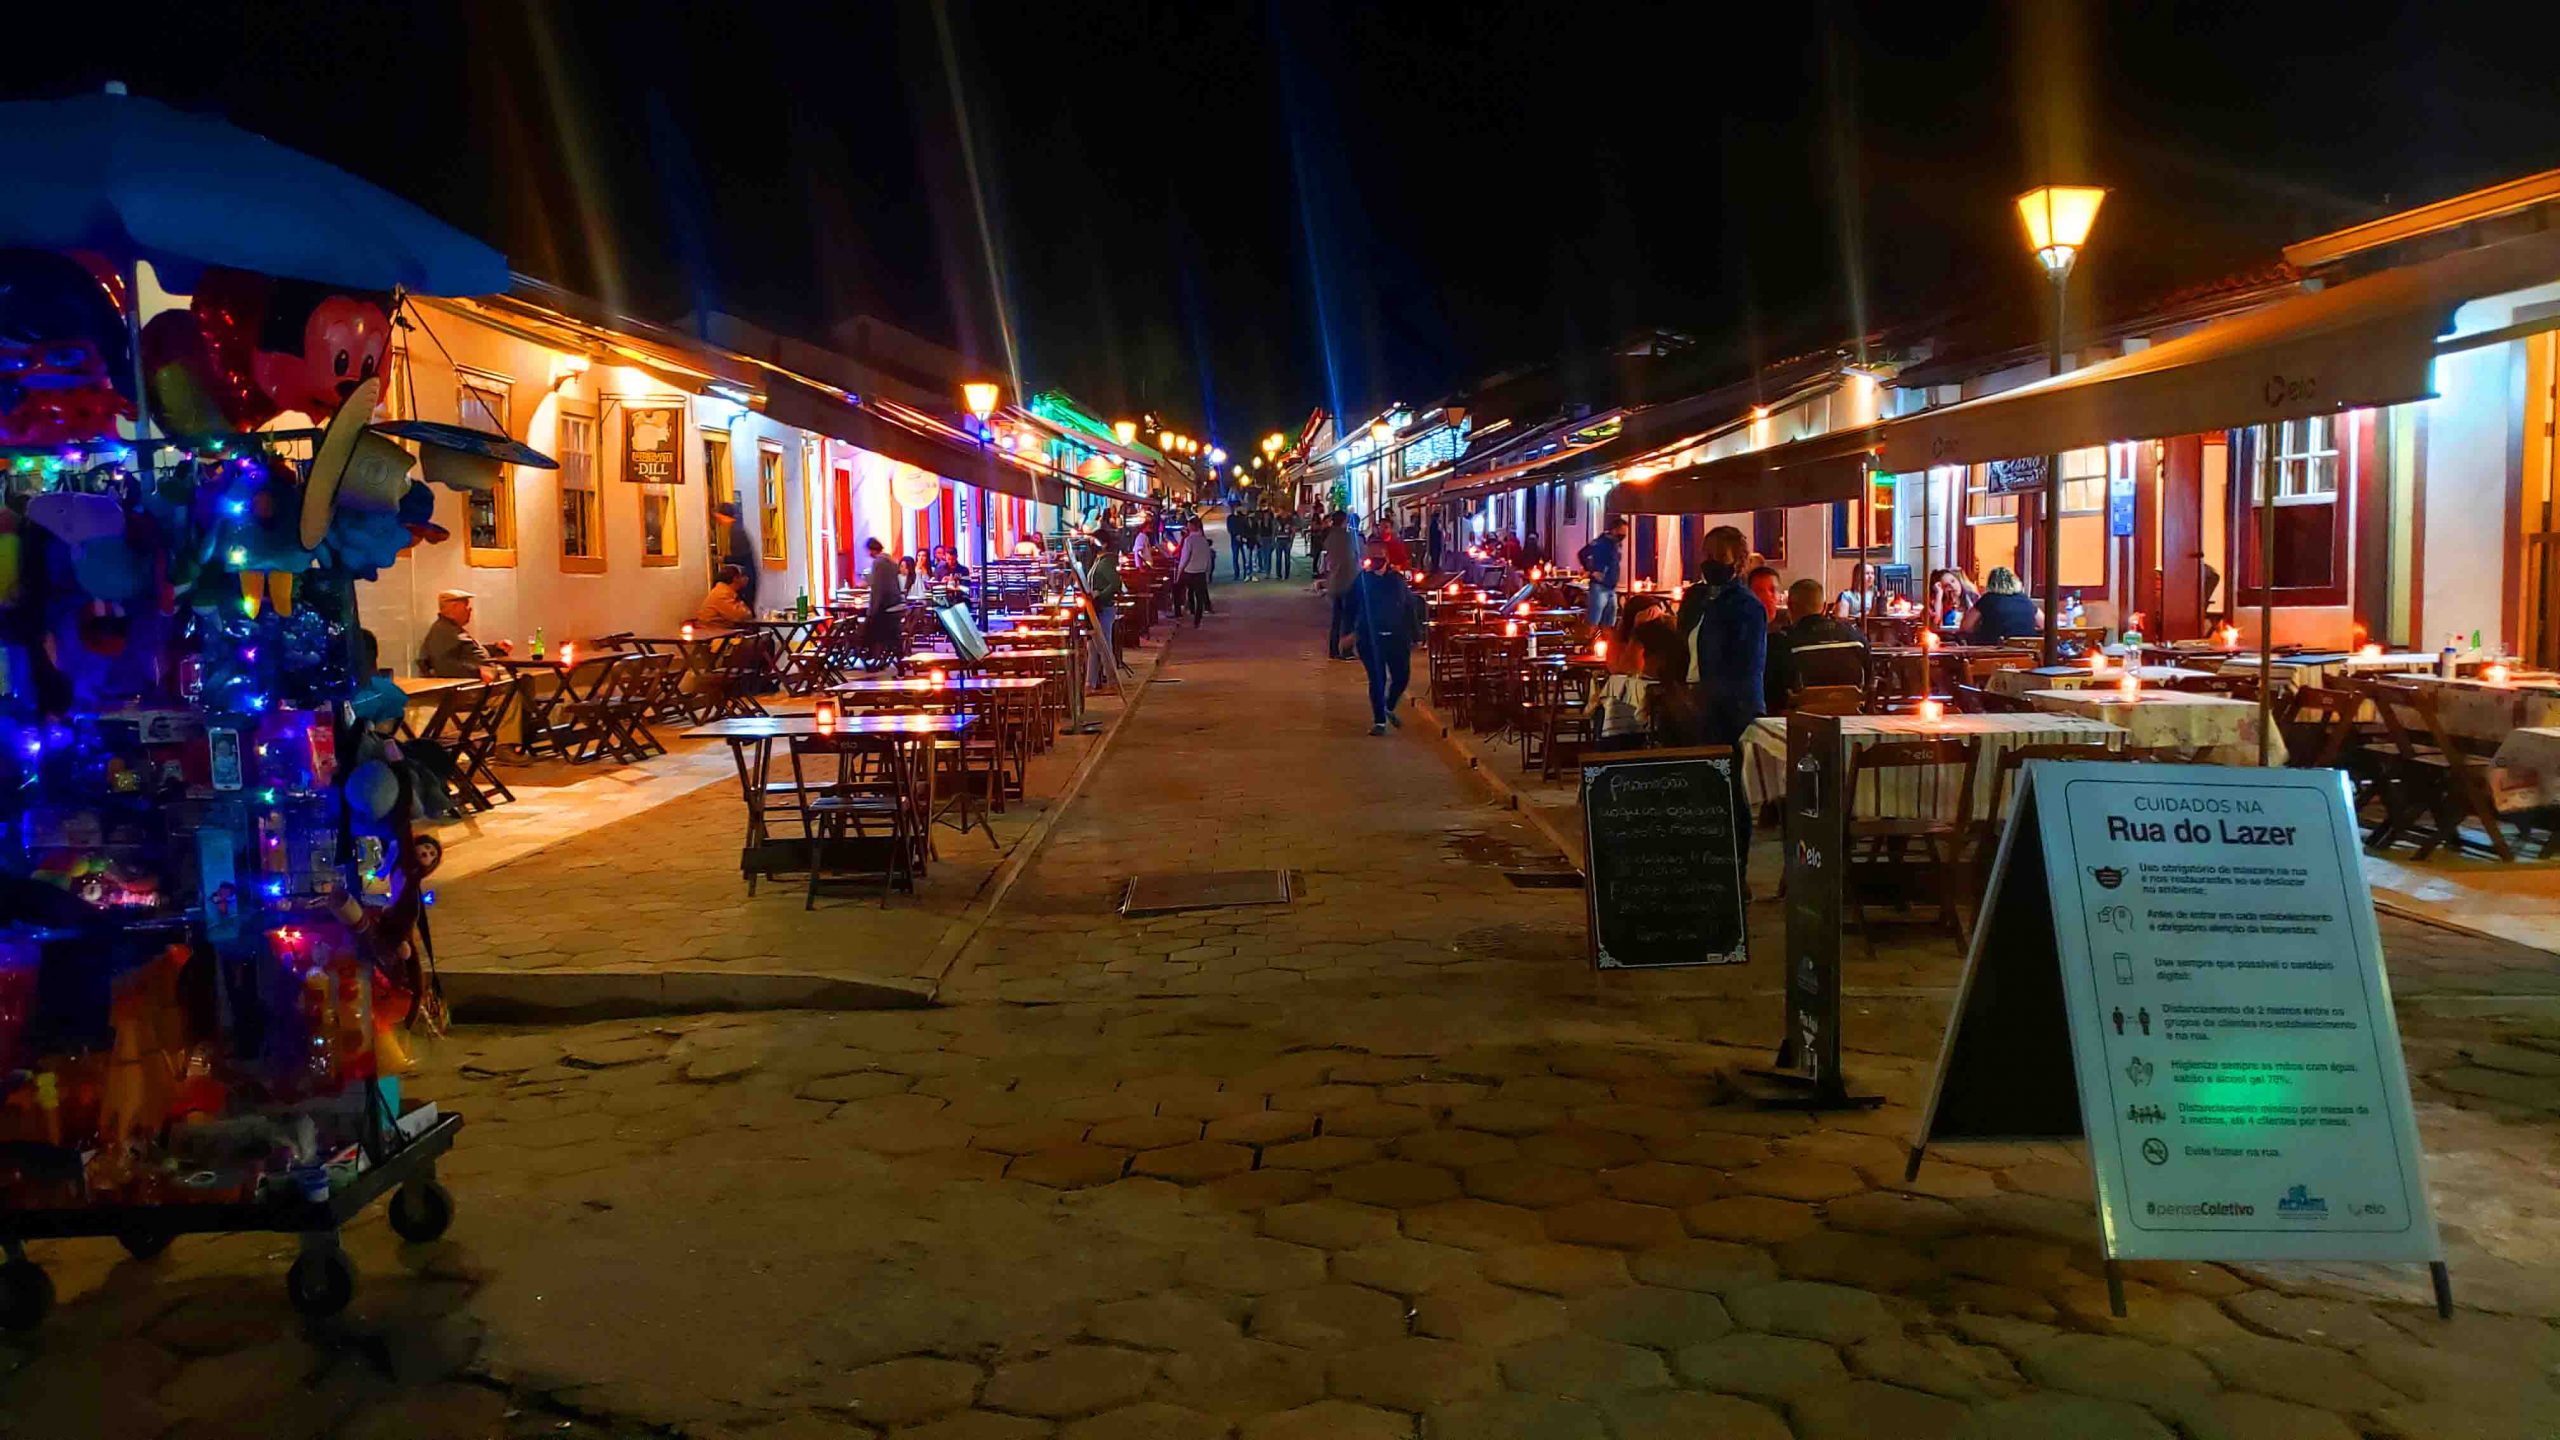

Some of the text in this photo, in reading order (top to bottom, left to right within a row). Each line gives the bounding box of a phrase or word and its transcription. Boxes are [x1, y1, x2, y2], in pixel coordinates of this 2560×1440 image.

[638, 462, 669, 475] DILL
[2134, 796, 2264, 814] CUIDADOS NA
[2107, 815, 2296, 846] Rua do Lazer
[2139, 863, 2159, 873] Uso
[2218, 865, 2230, 874] de
[2147, 909, 2173, 919] Antes
[2177, 959, 2213, 969] sempre
[2216, 960, 2235, 970] que
[2162, 1004, 2240, 1014] Distanciamento
[2243, 1006, 2255, 1015] de
[2258, 1006, 2264, 1015] 2
[2303, 1008, 2329, 1016] entre
[2164, 1018, 2200, 1028] grupos
[2220, 1062, 2259, 1072] sempre
[2306, 1064, 2328, 1072] com
[2178, 1103, 2259, 1114] Distanciamento
[2300, 1106, 2318, 1115] por
[2299, 1117, 2316, 1127] por
[2185, 1146, 2211, 1156] Evite
[2214, 1147, 2244, 1156] fumar
